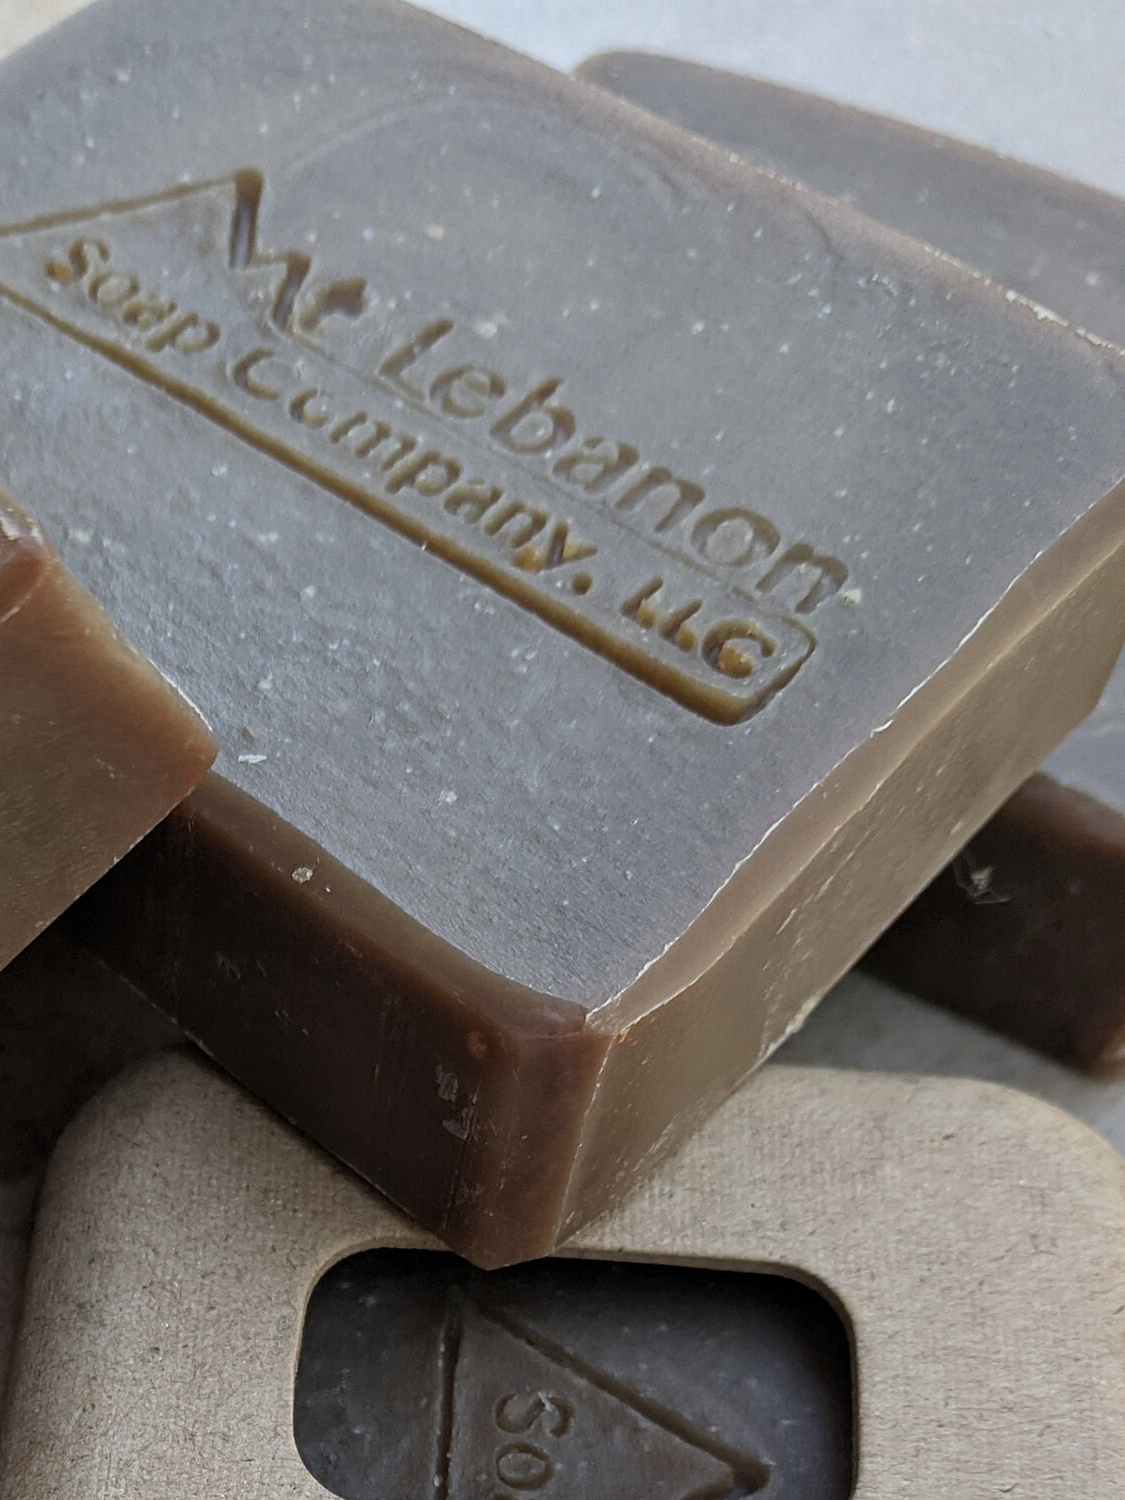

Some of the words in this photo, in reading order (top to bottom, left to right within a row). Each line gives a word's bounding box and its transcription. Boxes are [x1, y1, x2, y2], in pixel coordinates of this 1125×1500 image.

[43, 236, 221, 358] Soap
[620, 574, 777, 680] LLC
[375, 318, 851, 616] Lebanon
